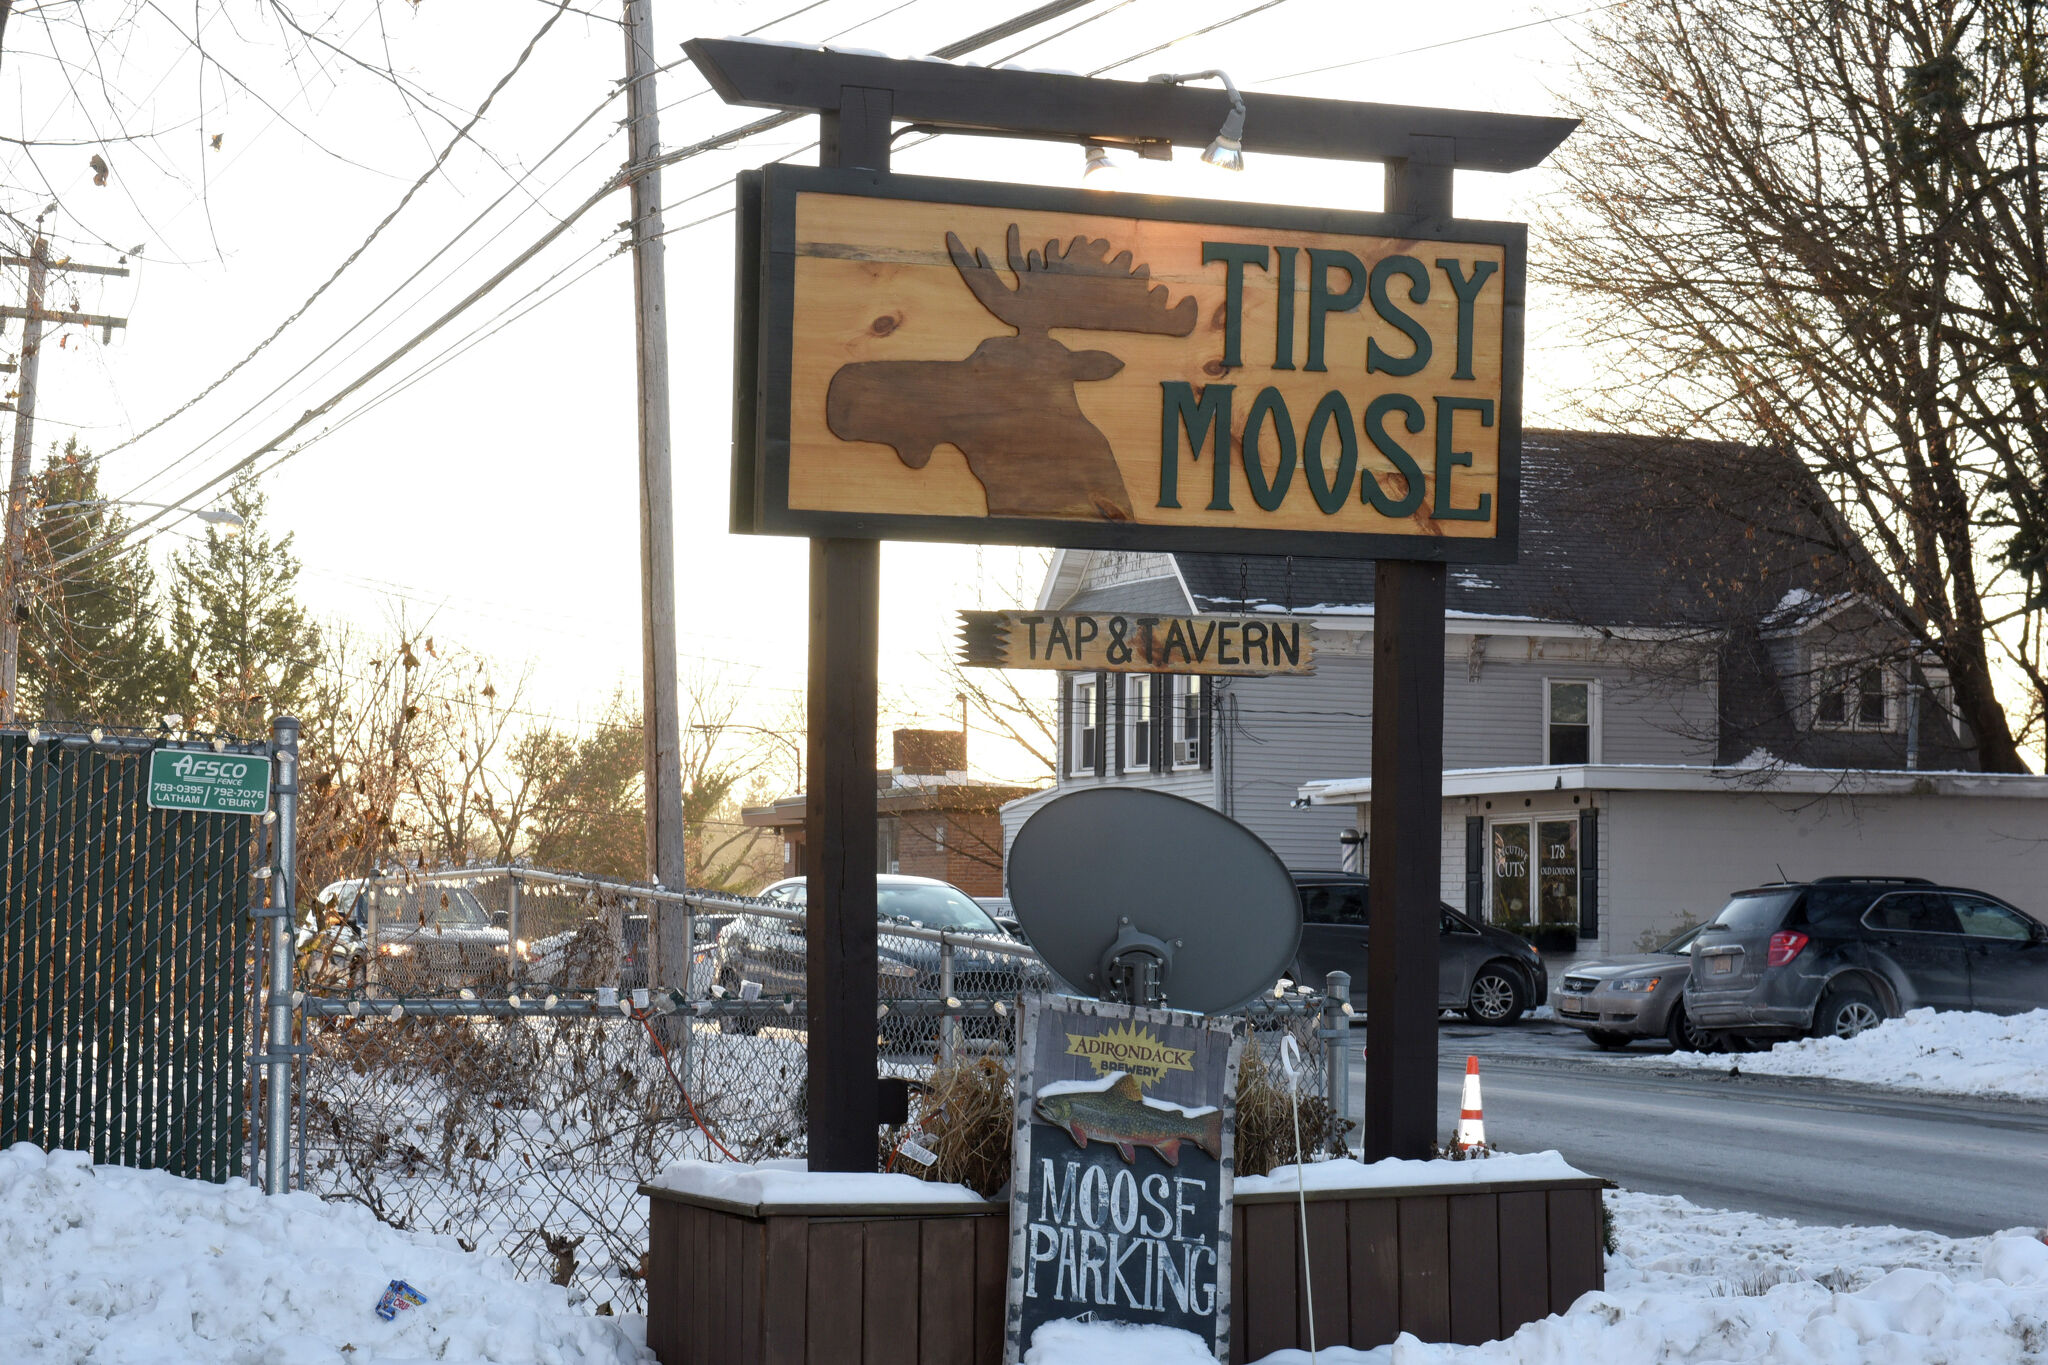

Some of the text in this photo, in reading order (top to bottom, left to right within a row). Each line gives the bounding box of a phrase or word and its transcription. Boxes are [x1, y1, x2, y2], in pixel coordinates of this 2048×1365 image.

[1202, 241, 1499, 381] TIPSY
[1155, 380, 1495, 522] MOOSE
[1020, 616, 1300, 667] TAP & TAVERN
[171, 754, 247, 779] AFSCO
[154, 782, 204, 795] 783-0395
[217, 777, 243, 786] FENCE
[156, 793, 201, 804] LATHAM
[213, 786, 265, 799] 792-7076
[1550, 844, 1566, 860] 178
[1497, 861, 1525, 878] CUTS
[1541, 866, 1576, 876] OLD LOUDON
[1074, 1036, 1189, 1066] ADIRONDACK
[1100, 1060, 1160, 1078] BREWERY
[1038, 1157, 1207, 1245] MOOSE
[1026, 1222, 1217, 1316] PARKING
